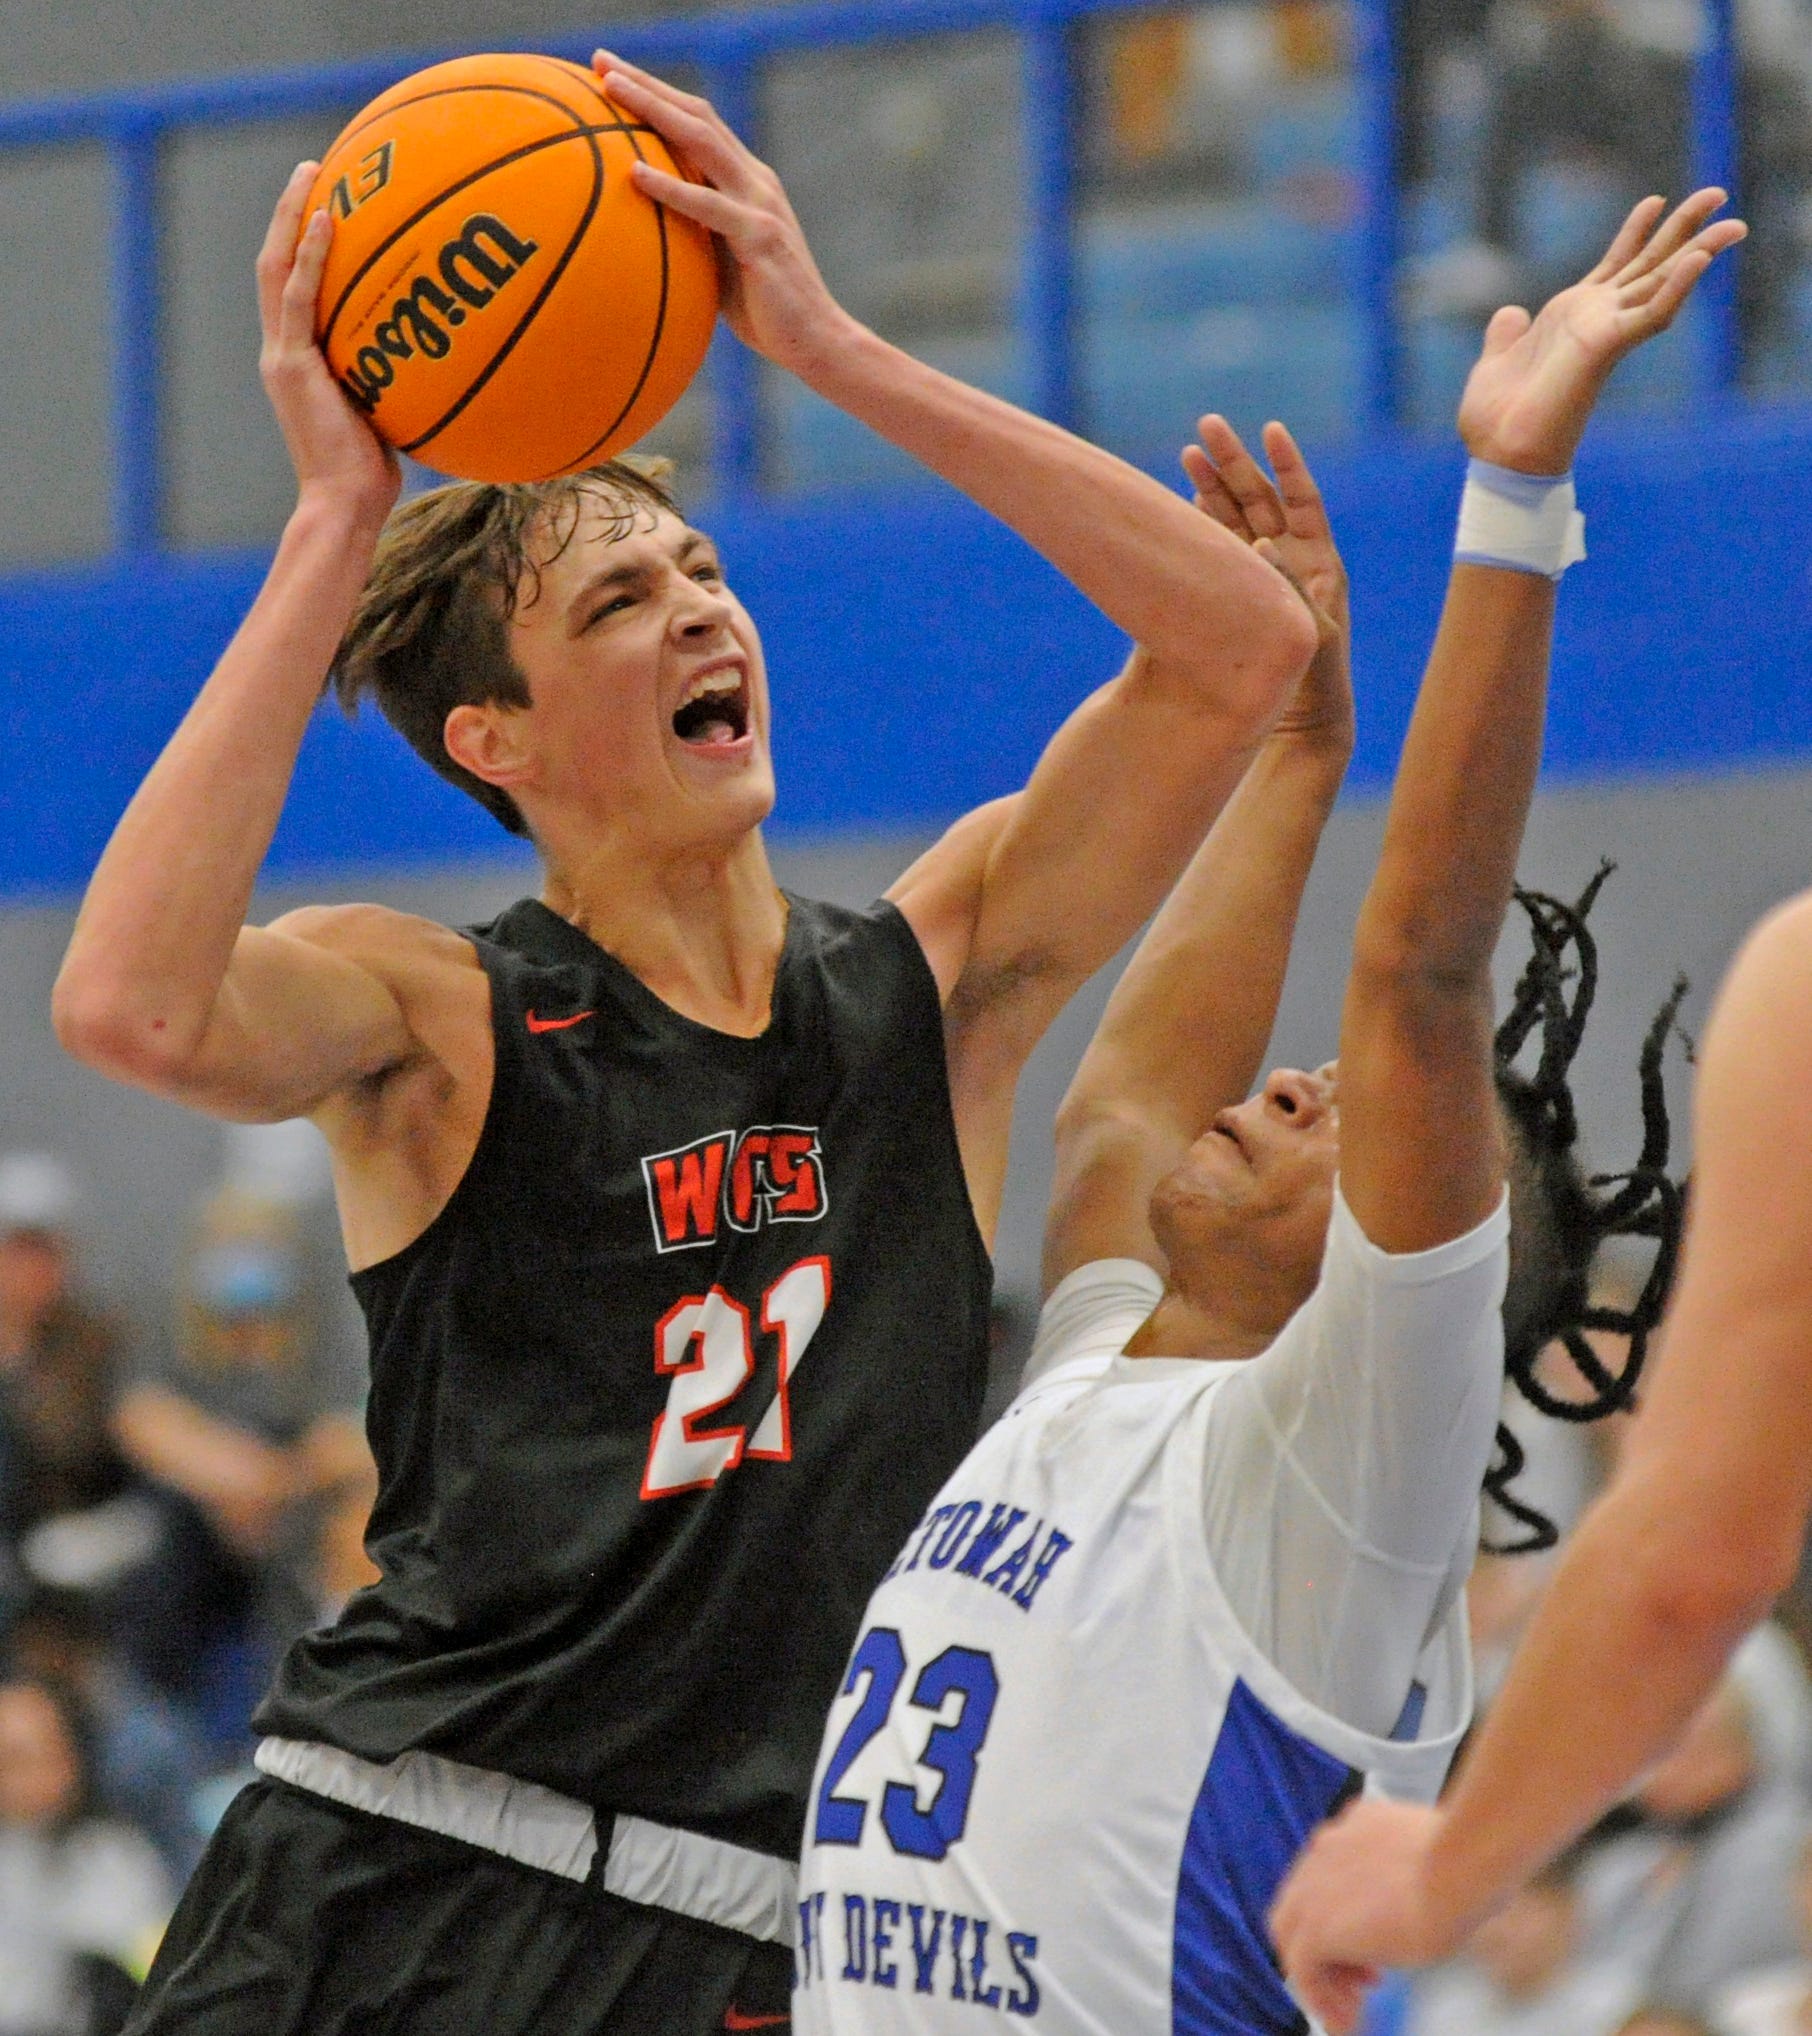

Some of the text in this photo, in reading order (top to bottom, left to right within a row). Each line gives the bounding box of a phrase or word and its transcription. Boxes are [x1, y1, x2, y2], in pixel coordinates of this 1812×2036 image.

[317, 139, 396, 221] EV
[639, 1255, 833, 1500] 21
[814, 1627, 1000, 1863] 23
[841, 1894, 1040, 2017] DEVILS
